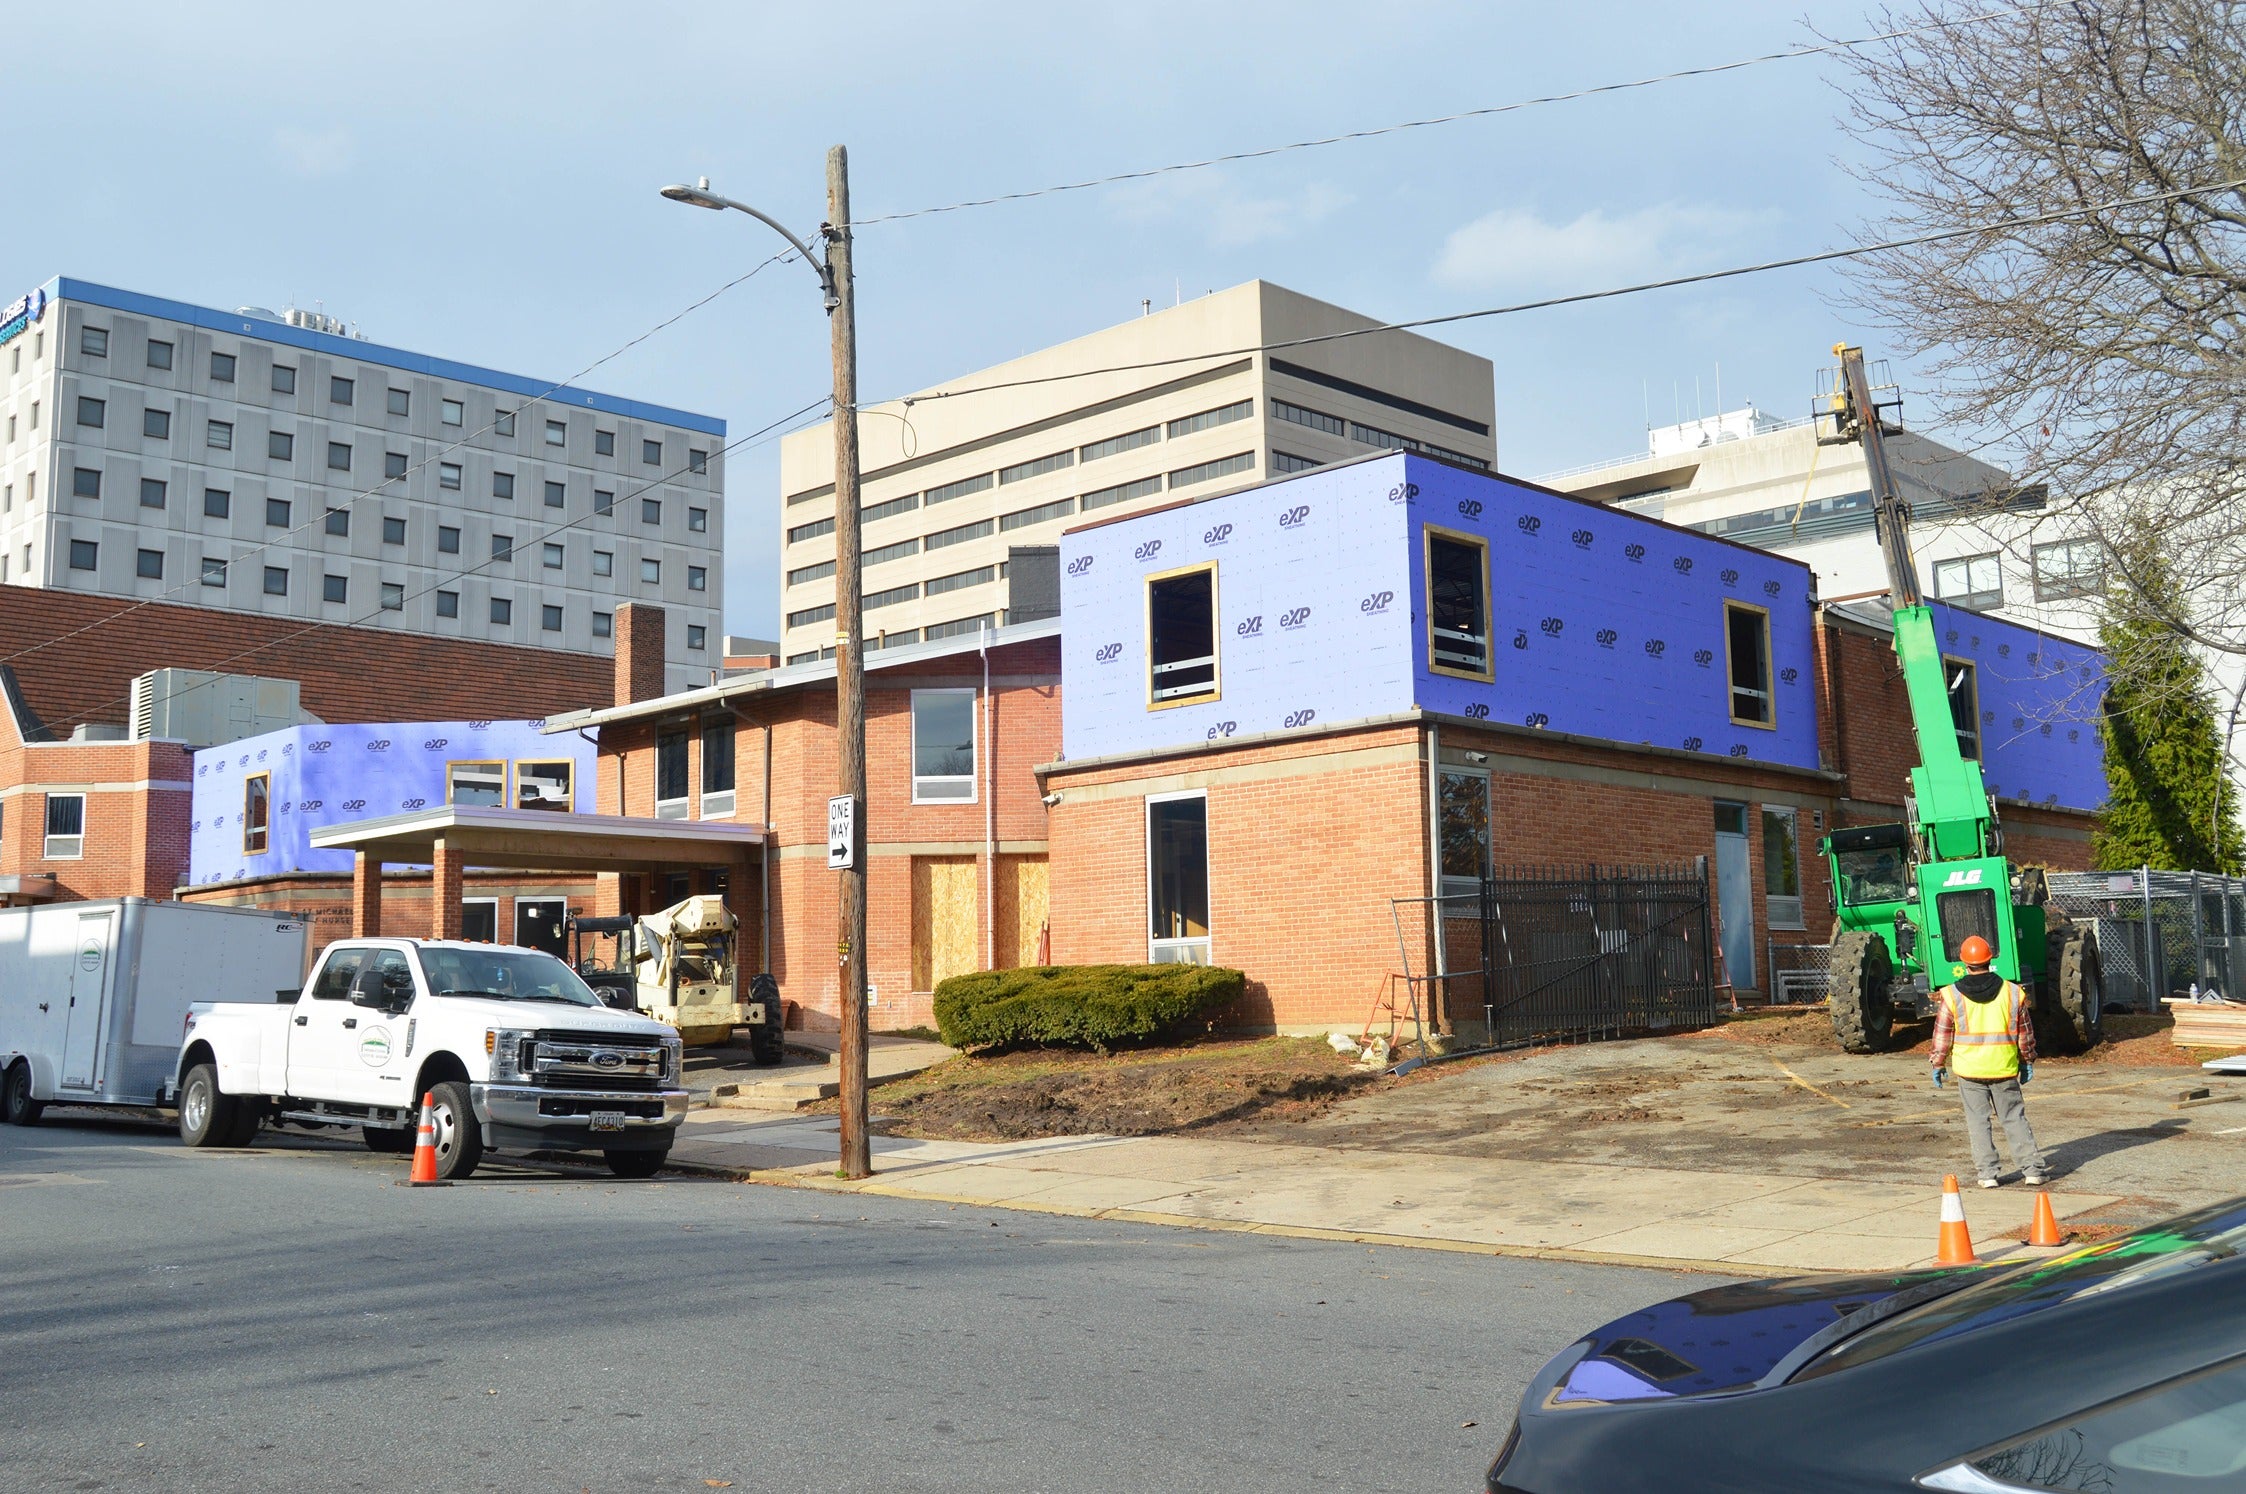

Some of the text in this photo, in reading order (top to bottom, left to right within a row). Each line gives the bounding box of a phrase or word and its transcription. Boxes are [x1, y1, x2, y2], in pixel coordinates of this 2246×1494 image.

[1388, 482, 1420, 502] eXP
[1279, 505, 1310, 526] eXP
[1458, 498, 1482, 516] eXP
[1518, 514, 1540, 532] eXP
[1204, 523, 1232, 544] eXP
[1572, 529, 1594, 546] eXP
[1134, 540, 1162, 559] eXP
[1625, 543, 1645, 560] eXP
[1067, 556, 1094, 574] eXP
[1674, 556, 1692, 572] eXP
[1720, 568, 1738, 584] eXP
[1764, 580, 1780, 594] eXP
[1360, 590, 1394, 612] eXP
[1280, 606, 1310, 627] eXP
[1541, 616, 1564, 634] eXP
[1596, 628, 1618, 645] eXP
[1096, 642, 1122, 662] eXP
[1645, 638, 1665, 655] eXP
[1694, 649, 1712, 664] eXP
[1780, 668, 1798, 682] eXP
[1284, 709, 1316, 728] eXP
[1465, 703, 1490, 719] eXP
[1207, 720, 1237, 740] eXP
[308, 741, 332, 750] eXP
[368, 740, 390, 750] eXP
[424, 739, 448, 749] eXP
[1684, 736, 1702, 752] eXP
[300, 800, 322, 810] eXP
[342, 800, 366, 810] eXP
[402, 798, 426, 808] eXP
[831, 802, 849, 820] ONE
[830, 822, 850, 840] WAY
[1942, 869, 1982, 887] JLG
[600, 1056, 617, 1066] Ford
